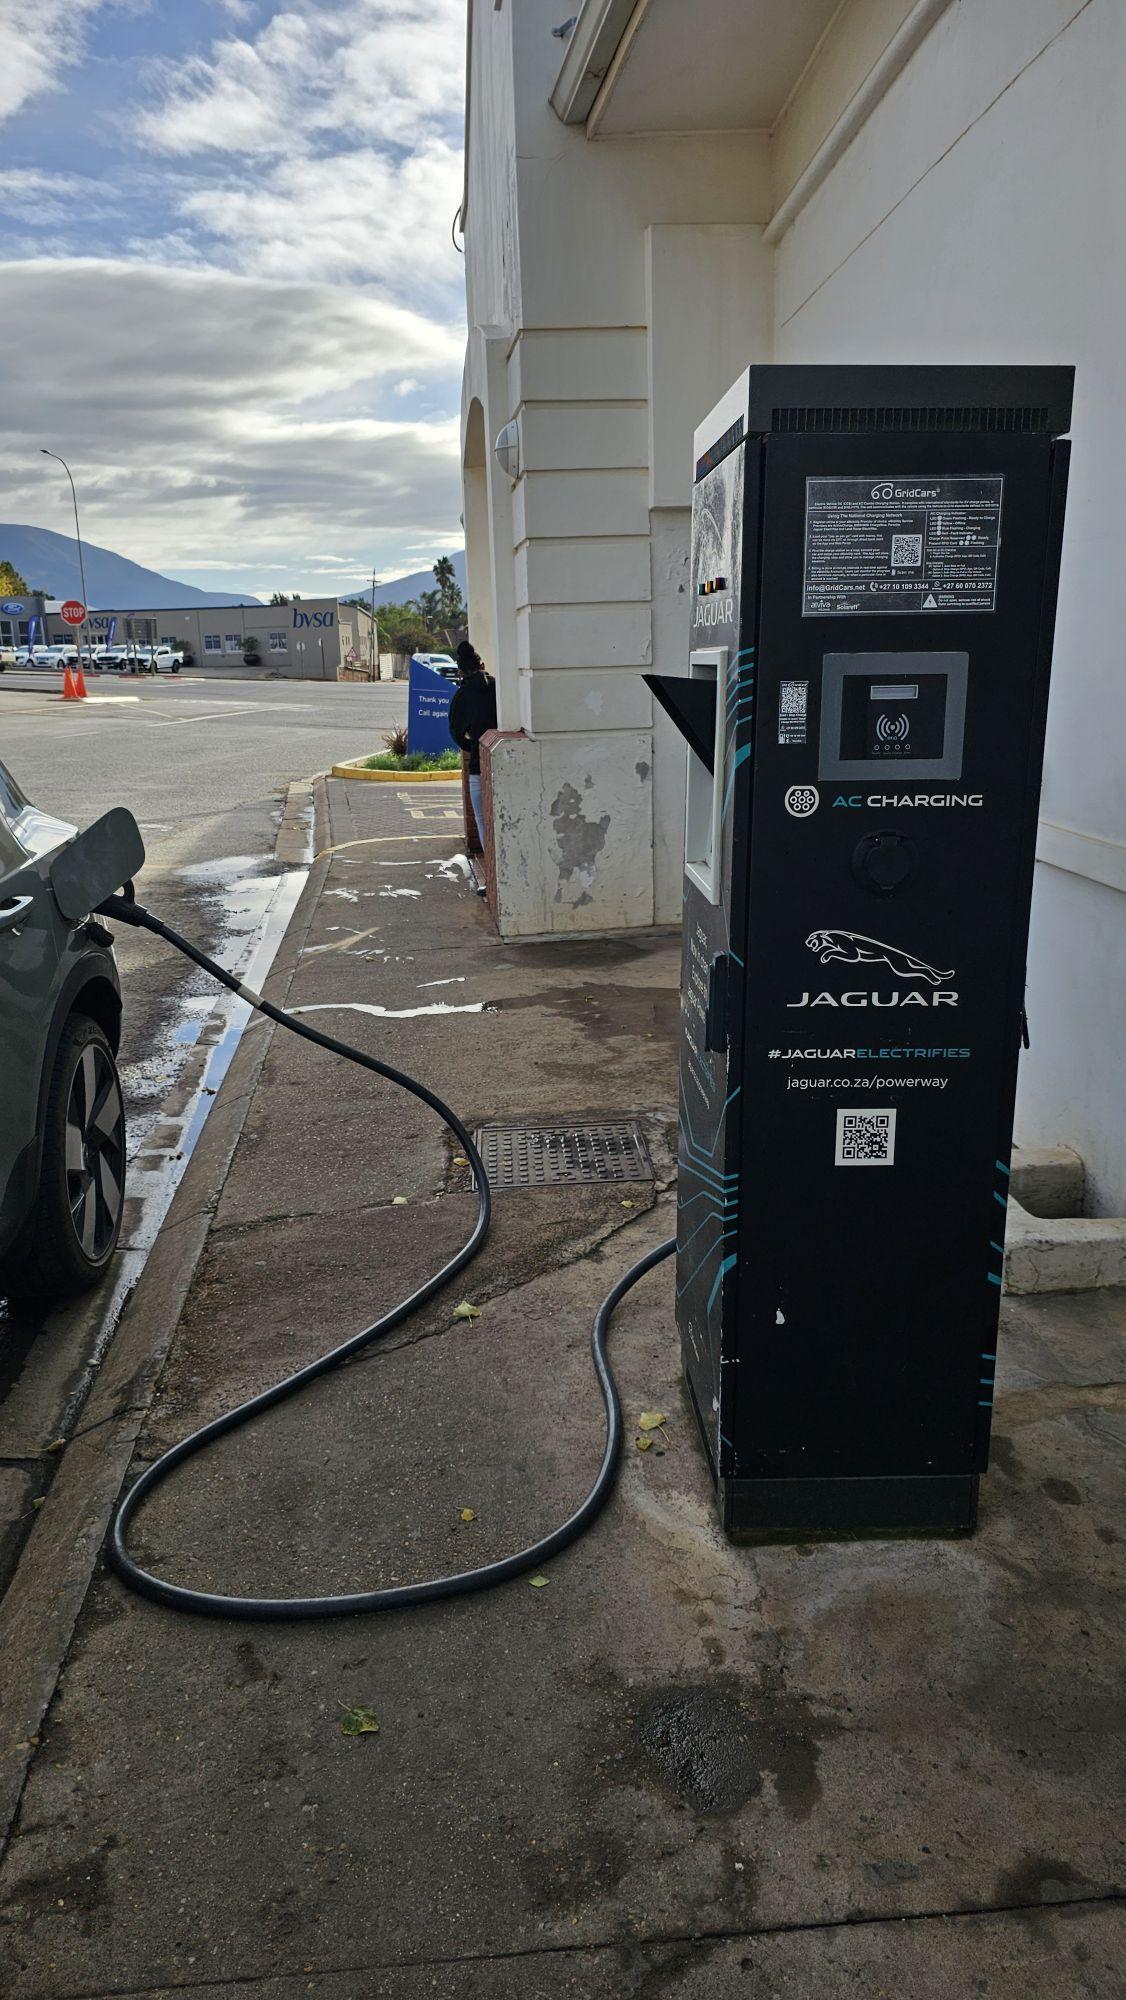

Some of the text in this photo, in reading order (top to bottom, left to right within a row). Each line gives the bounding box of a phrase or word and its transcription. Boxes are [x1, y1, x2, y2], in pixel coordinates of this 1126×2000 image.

[63, 607, 85, 618] STOP
[292, 607, 334, 628] bvsa
[693, 597, 733, 628] JAGUAR
[419, 695, 436, 703] Thank
[832, 794, 983, 807] AC CHARGING
[787, 991, 959, 1007] JAGUAR
[768, 1048, 971, 1059] #JAGUARELECTRIFIES
[787, 1075, 948, 1090] jaguar.co.za/powerway
